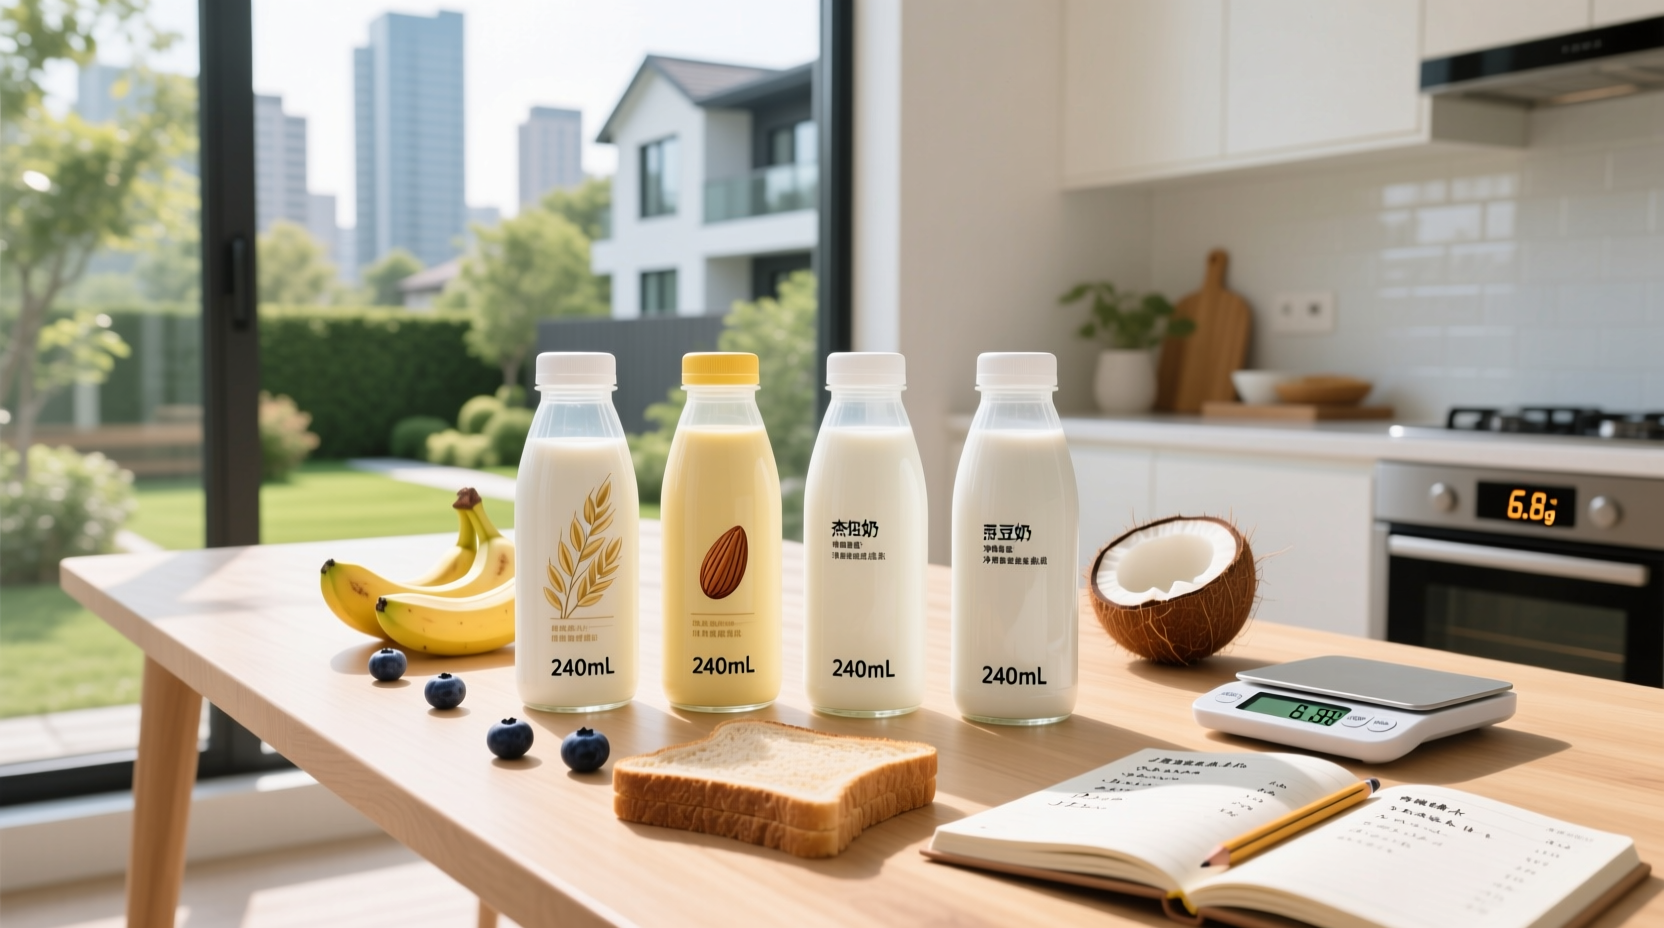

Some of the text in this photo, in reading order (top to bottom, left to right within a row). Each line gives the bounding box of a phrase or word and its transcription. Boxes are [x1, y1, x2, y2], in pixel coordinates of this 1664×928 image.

[551, 656, 615, 677] 240mL
[692, 655, 755, 675] 240mL
[832, 658, 896, 678] 240mL
[982, 665, 1047, 685] 240mL
